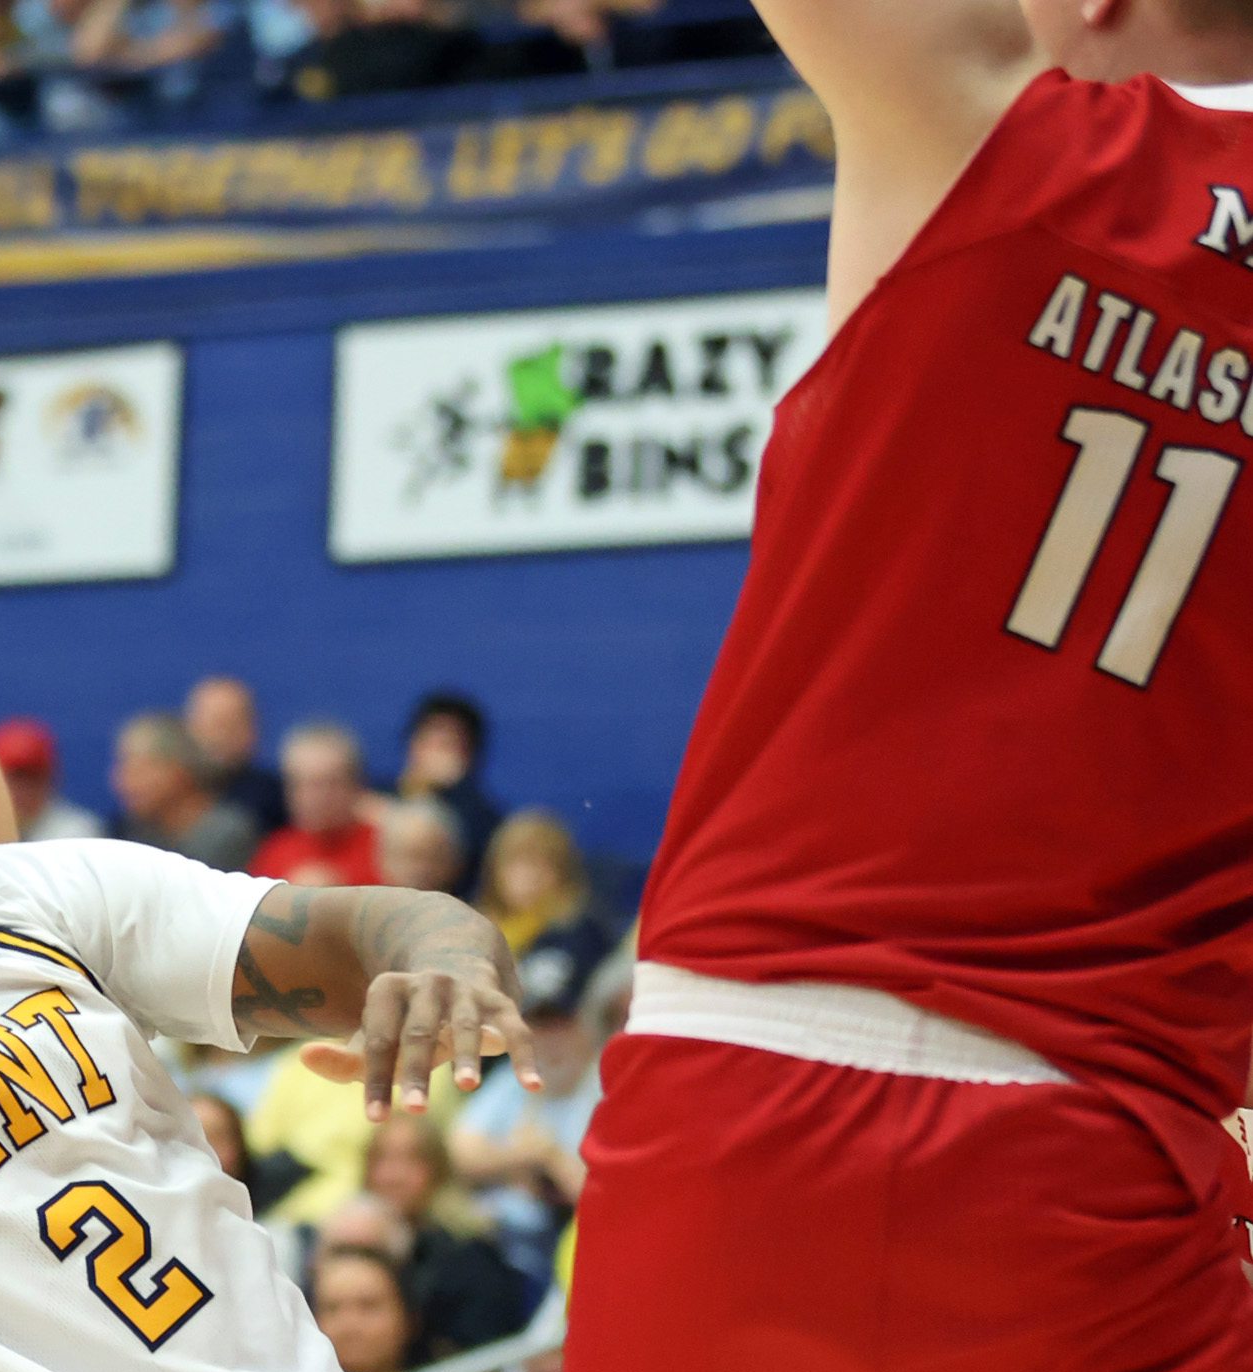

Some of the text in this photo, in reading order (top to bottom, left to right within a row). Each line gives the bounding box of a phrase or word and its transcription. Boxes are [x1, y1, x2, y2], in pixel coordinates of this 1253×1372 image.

[1025, 269, 1253, 436] ATLAS
[1001, 402, 1245, 692] 11
[36, 1179, 215, 1354] 2
